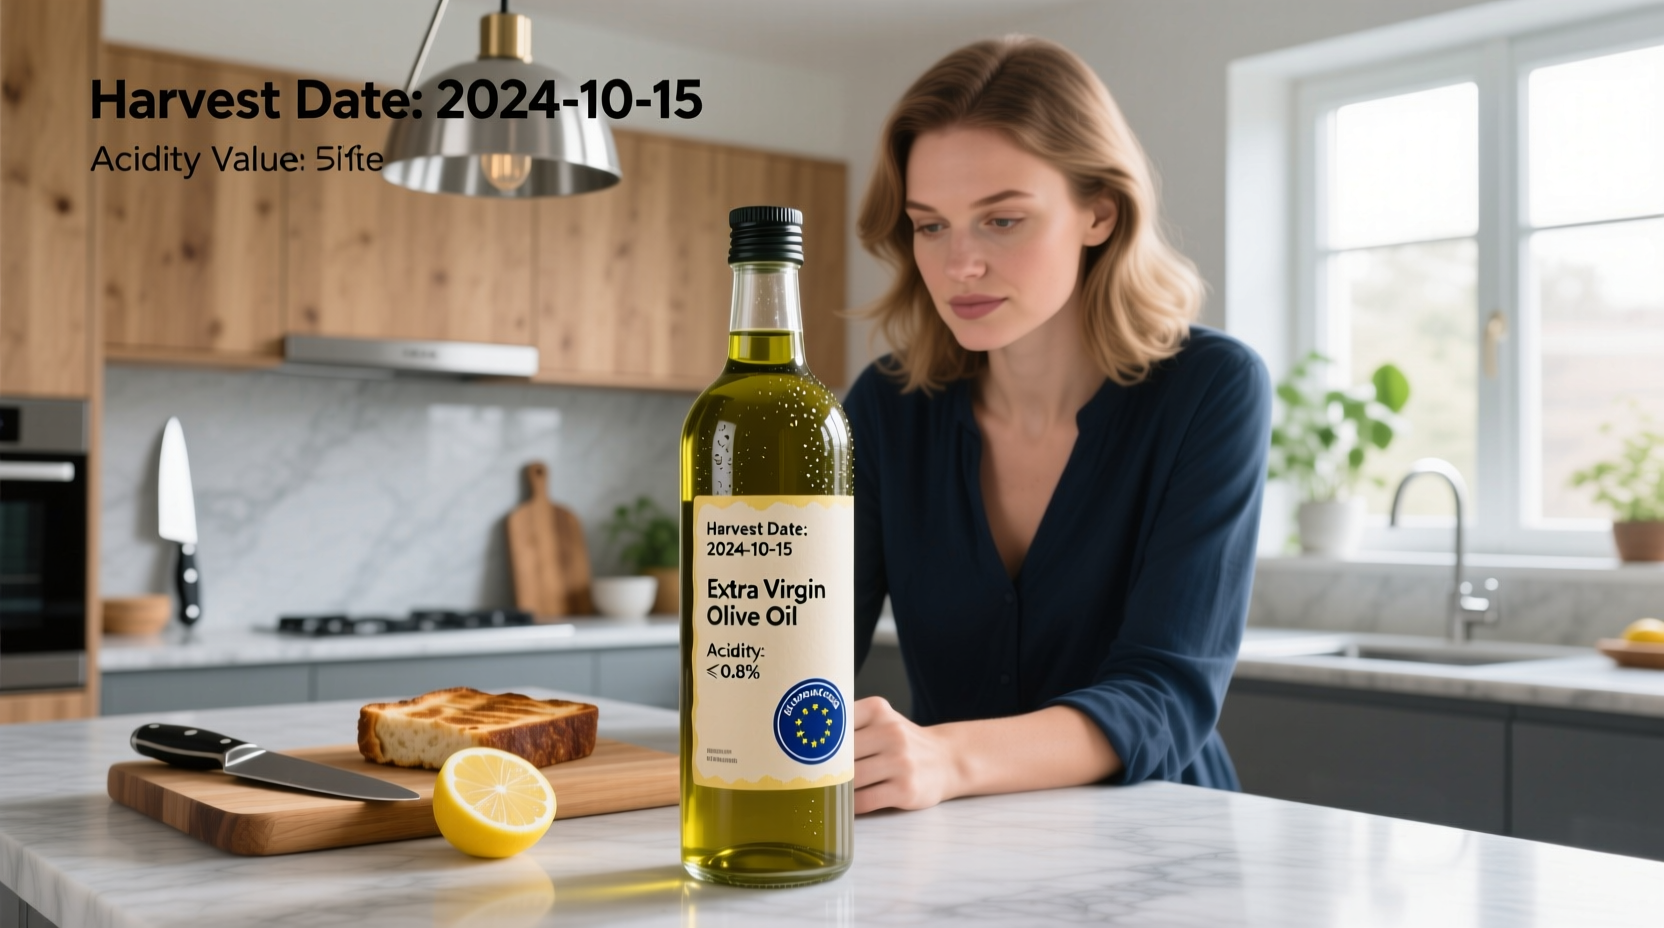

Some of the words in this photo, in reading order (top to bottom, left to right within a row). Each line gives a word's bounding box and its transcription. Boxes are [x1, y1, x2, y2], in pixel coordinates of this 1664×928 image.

[706, 521, 763, 537] Harvest
[767, 521, 808, 537] Date:
[706, 541, 793, 557] 2024-10-15
[707, 578, 759, 600] Extra
[763, 578, 826, 605] Virgin
[706, 605, 760, 627] Olive
[765, 605, 798, 627] Oil
[706, 642, 765, 664] Acidity:
